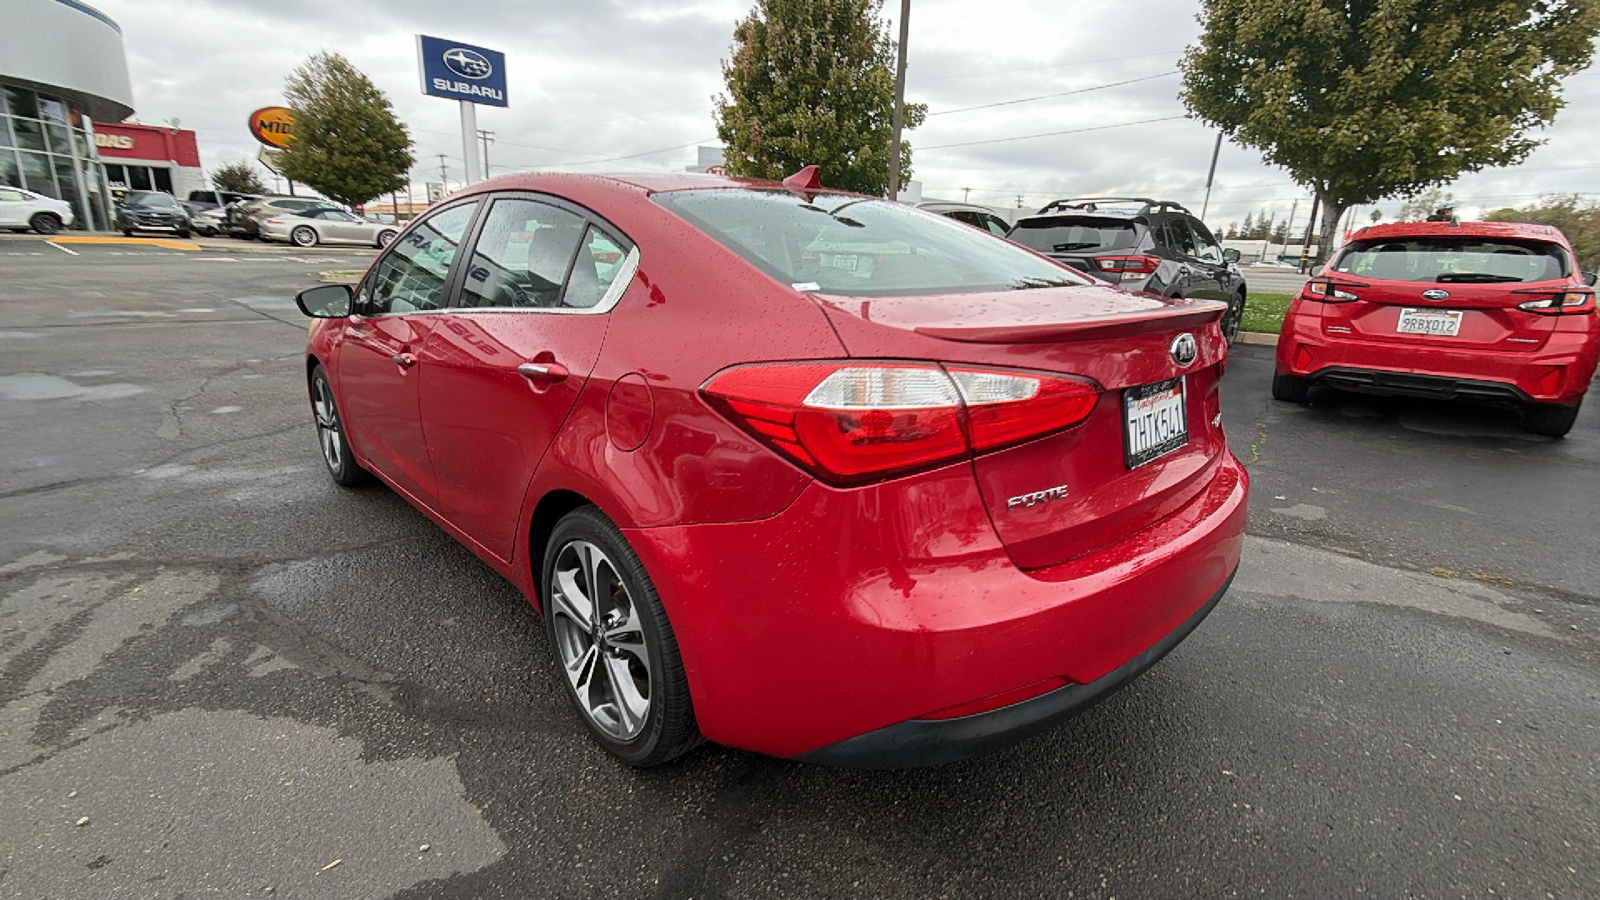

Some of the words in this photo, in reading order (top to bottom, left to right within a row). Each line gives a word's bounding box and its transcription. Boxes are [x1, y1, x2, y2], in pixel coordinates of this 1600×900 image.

[433, 77, 503, 100] SUBARU
[1403, 318, 1455, 332] 9RBX012
[1129, 403, 1183, 453] 7HTK541
[1007, 484, 1069, 511] FORTE
